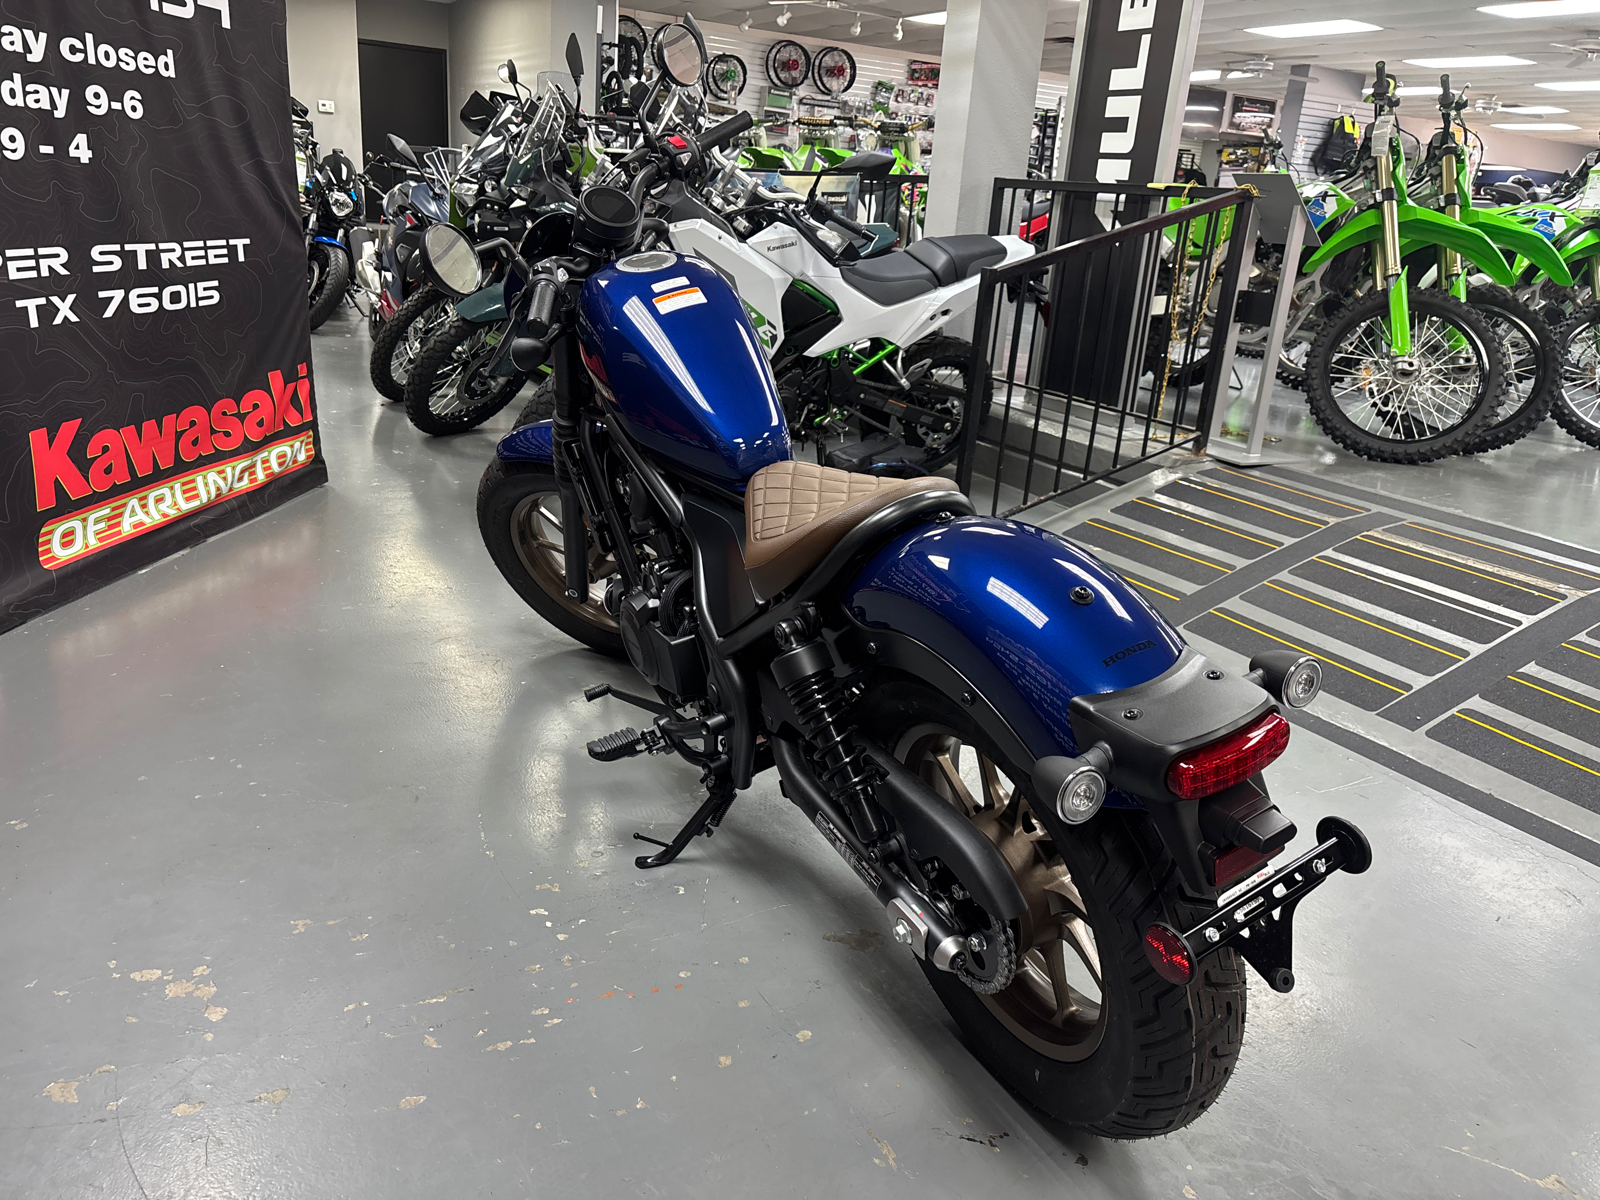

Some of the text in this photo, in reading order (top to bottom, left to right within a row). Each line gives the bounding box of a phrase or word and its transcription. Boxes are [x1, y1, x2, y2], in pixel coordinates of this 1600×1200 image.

[60, 32, 176, 78] closed
[1, 74, 144, 120] day 9-6
[1, 127, 25, 160] 9
[68, 133, 93, 163] 4
[0, 238, 251, 280] ER STREET
[766, 240, 798, 252] Kawasaki
[15, 280, 220, 329] TX 76015
[29, 362, 313, 511] Kawasaki
[52, 437, 306, 558] OF ARLINGTON
[1102, 639, 1157, 667] HONDA
